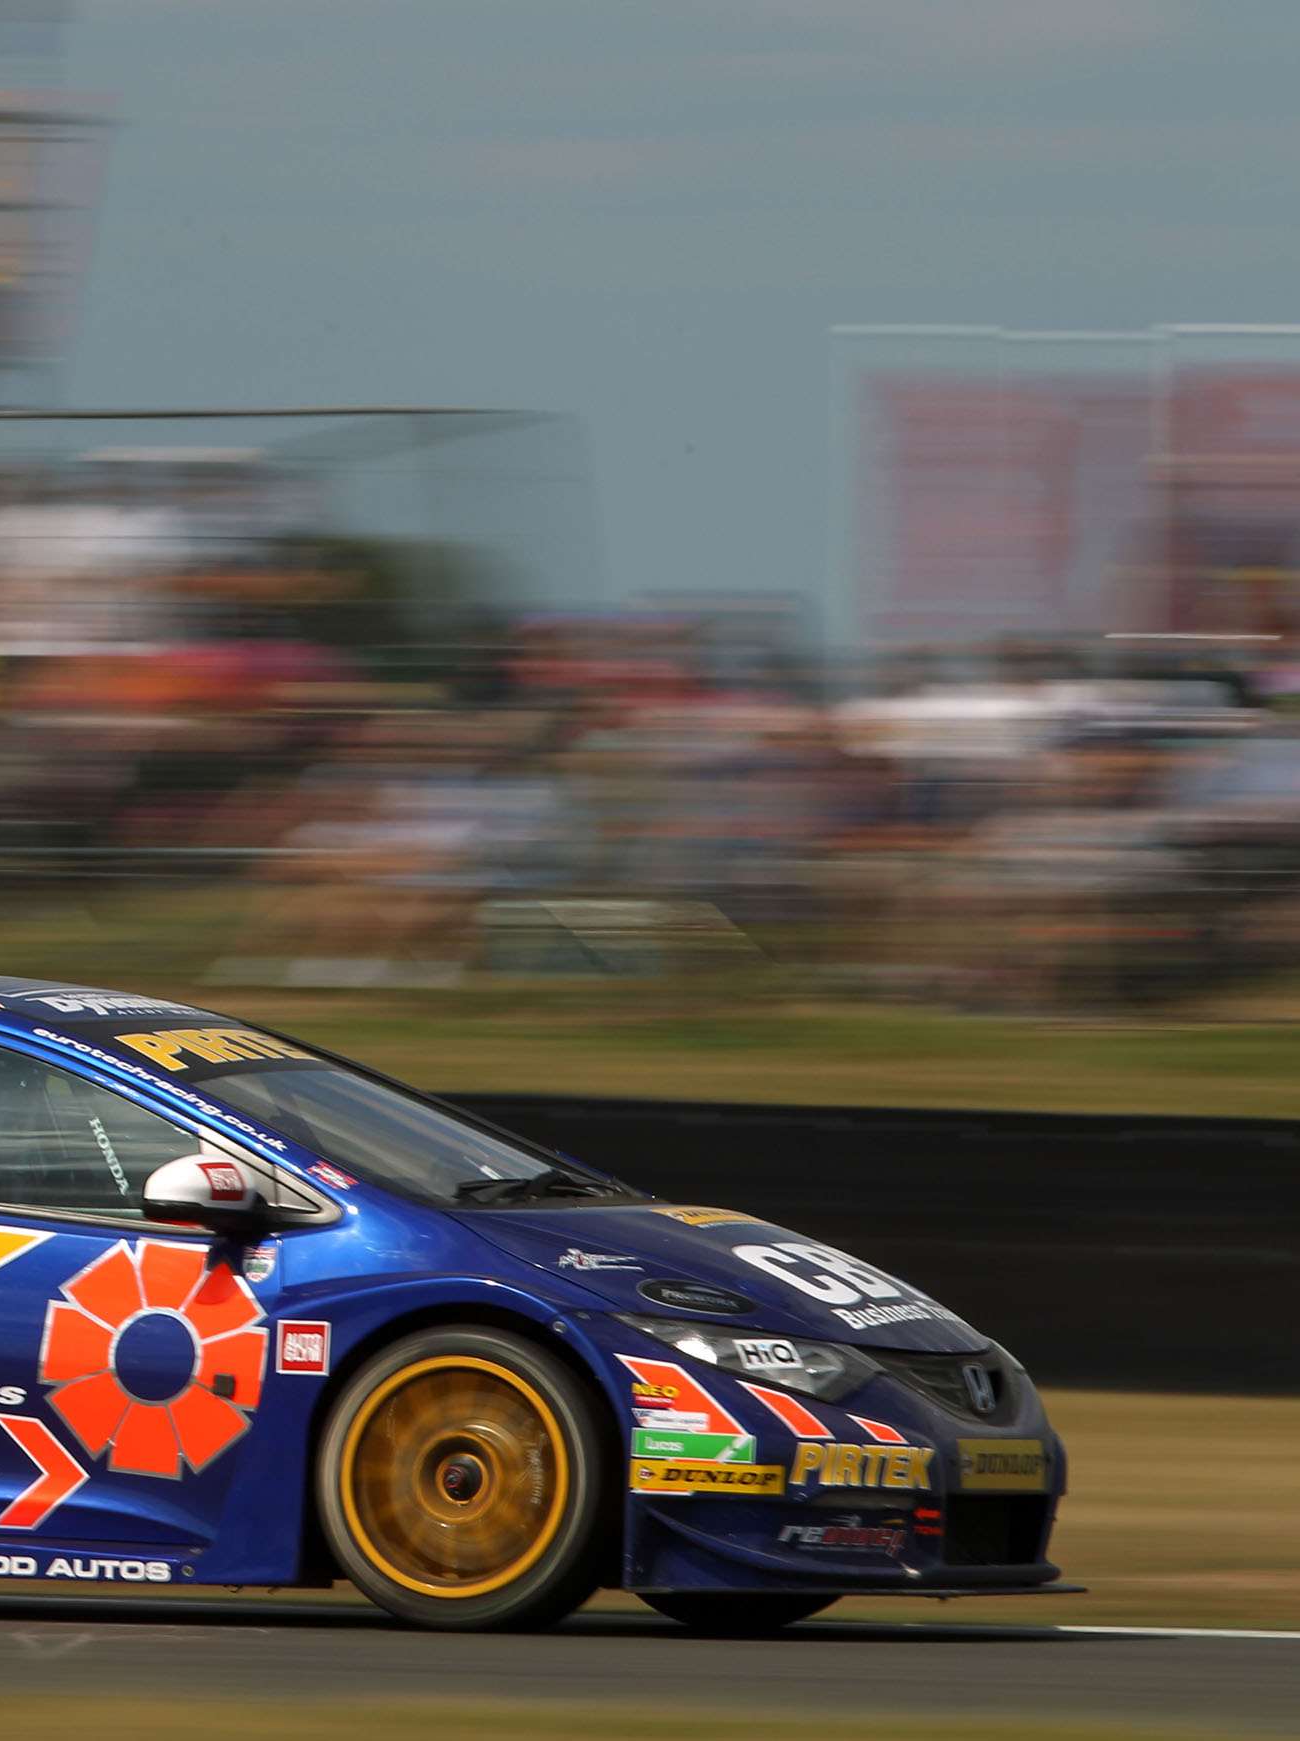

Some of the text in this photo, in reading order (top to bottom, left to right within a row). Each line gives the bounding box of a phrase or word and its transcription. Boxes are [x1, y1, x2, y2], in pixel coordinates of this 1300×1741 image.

[31, 1027, 289, 1153] eurotechracing.co.uk
[88, 1115, 130, 1197] HONDA
[829, 1302, 932, 1330] Business
[738, 1343, 796, 1365] HiQ
[631, 1383, 681, 1399] NEO
[661, 1468, 779, 1486] DUNLOP
[789, 1442, 936, 1491] PIRTEK
[45, 1558, 172, 1583] AUTOS
